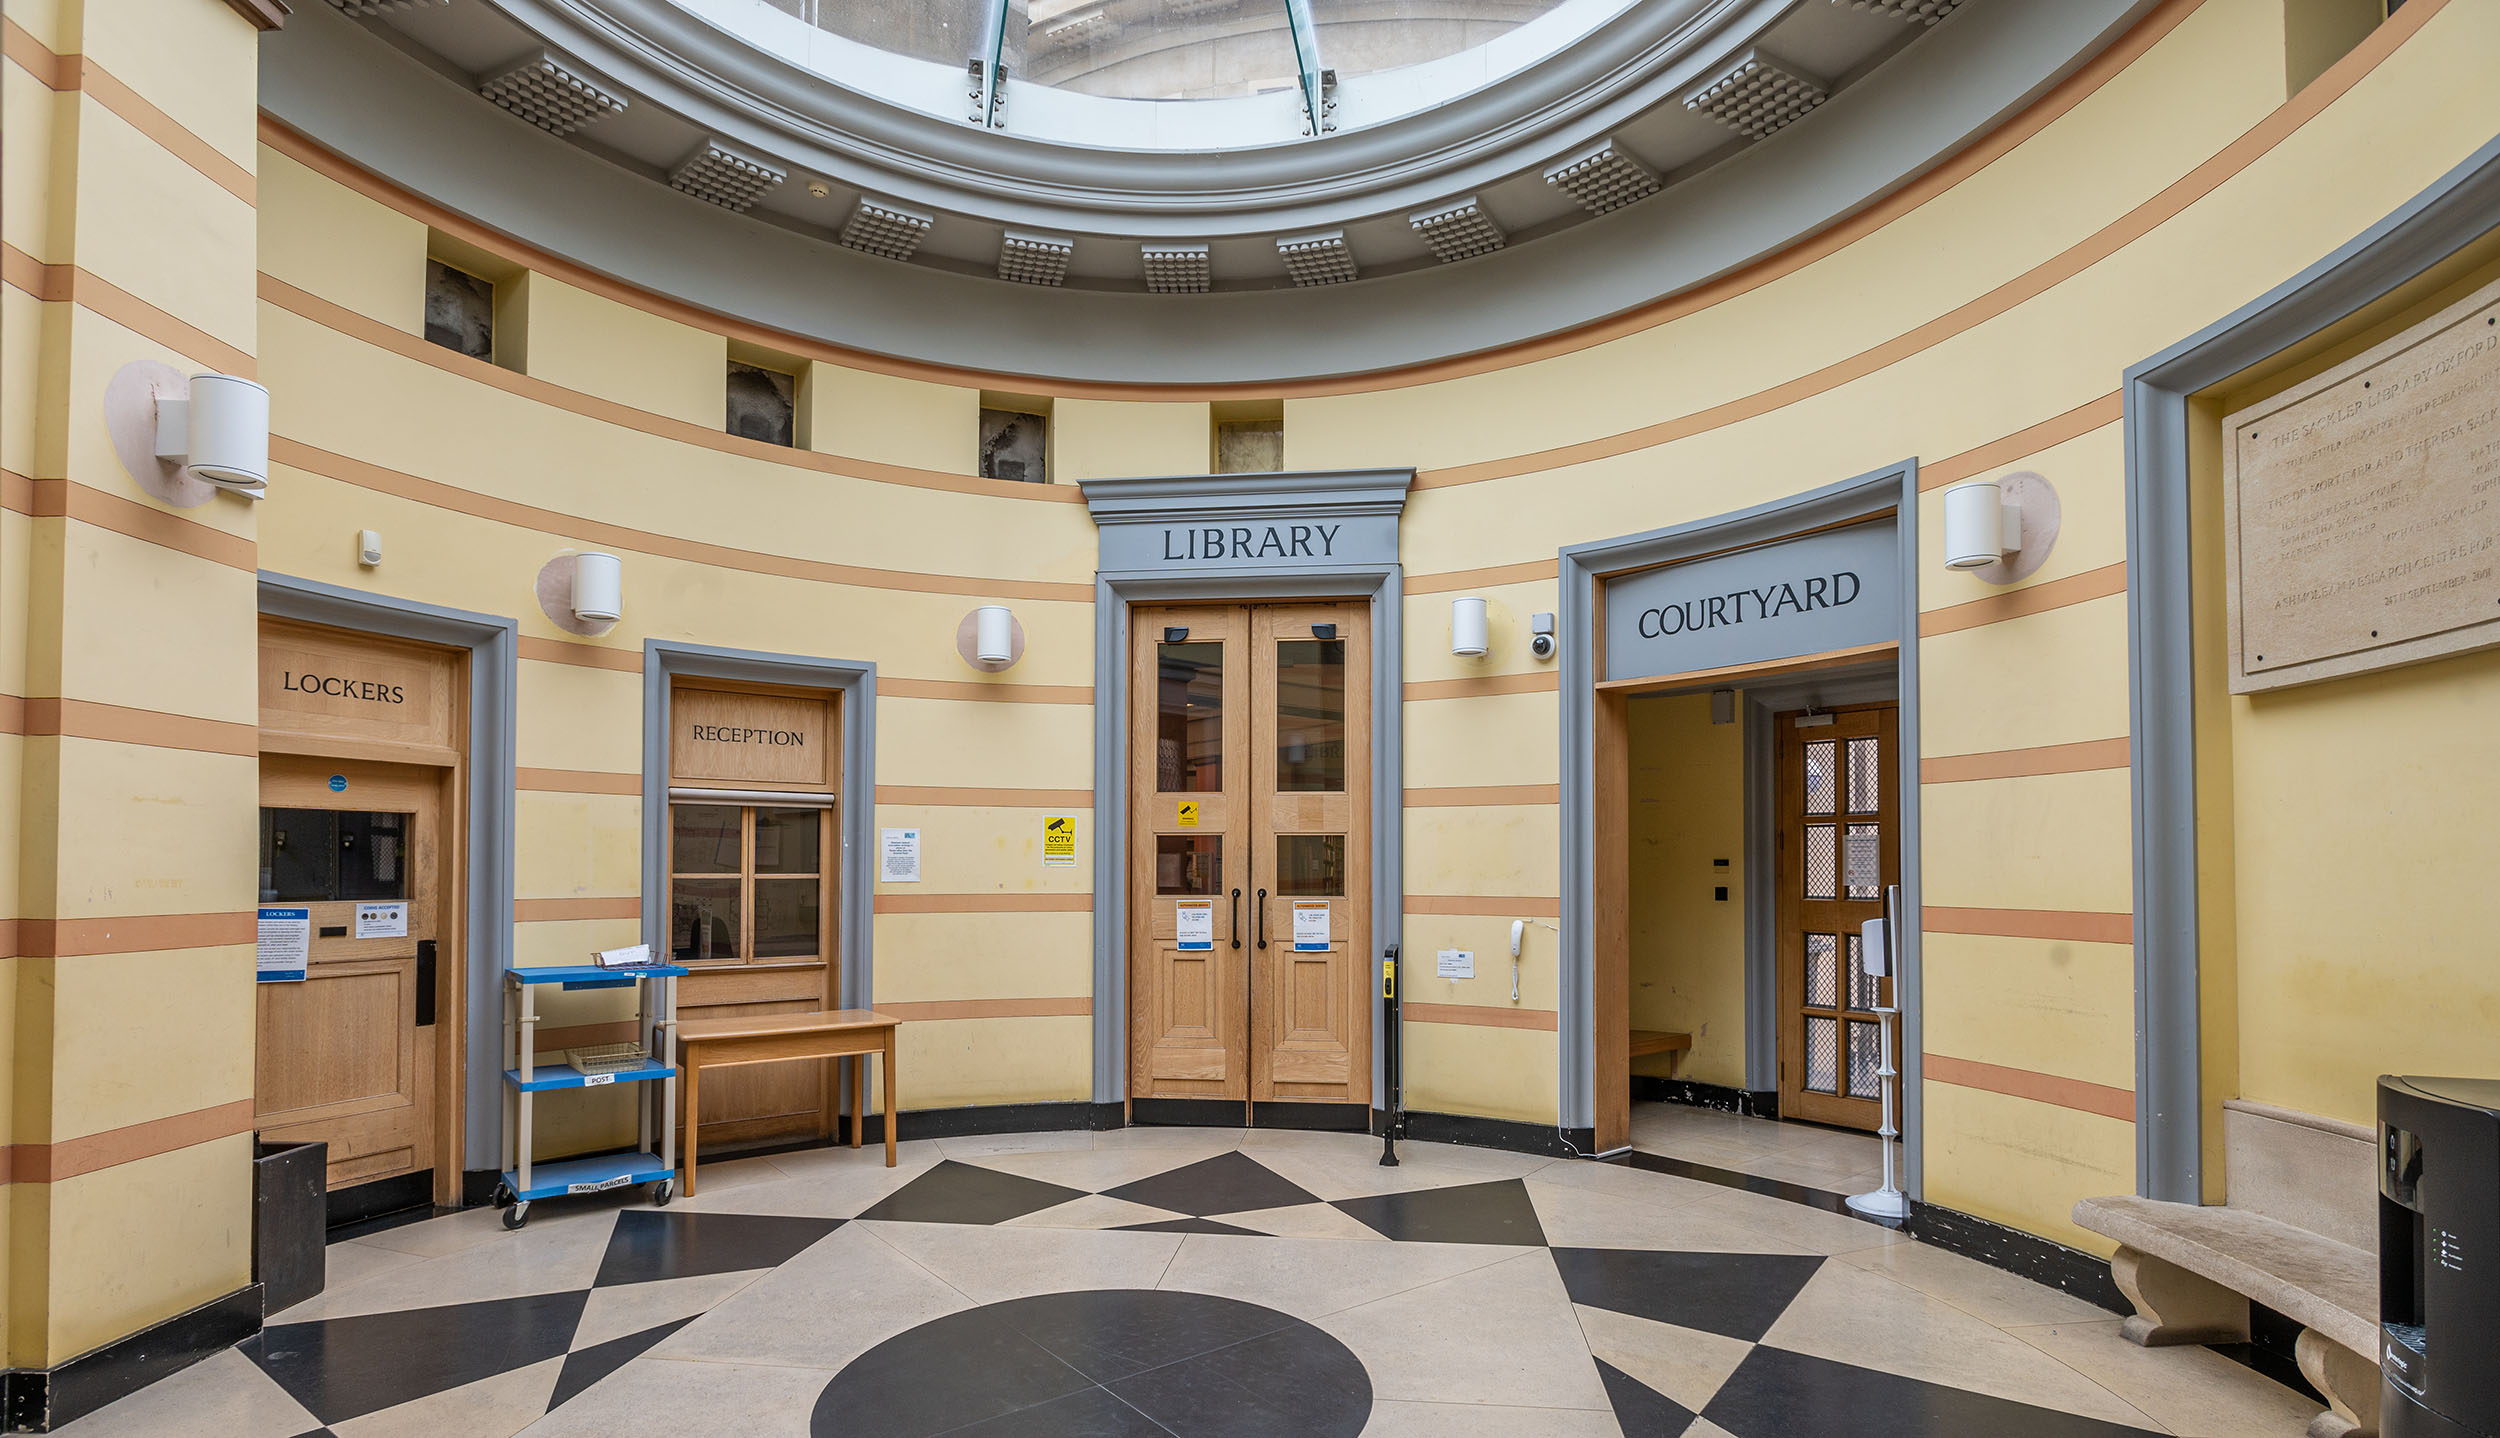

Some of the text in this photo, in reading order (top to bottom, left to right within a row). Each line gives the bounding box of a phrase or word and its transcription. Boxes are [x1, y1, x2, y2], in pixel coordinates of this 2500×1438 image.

[2271, 426, 2299, 451] THE
[2301, 398, 2362, 439] SACKLER
[2367, 366, 2432, 409] LIBRARY
[2435, 333, 2497, 377] OXFORD
[2405, 422, 2463, 458] THERESA
[1162, 524, 1341, 560] LIBRARY
[2347, 561, 2411, 590] RESEARCH
[2414, 544, 2467, 571] CENTRE
[2407, 574, 2467, 600] SEPTEMBER
[1638, 571, 1861, 639] COURTYARD
[283, 671, 405, 705] LOCKERS
[693, 724, 804, 746] RECEPTION
[1048, 835, 1071, 843] CCTV
[591, 1075, 610, 1084] POST
[600, 1176, 629, 1189] PARCELS
